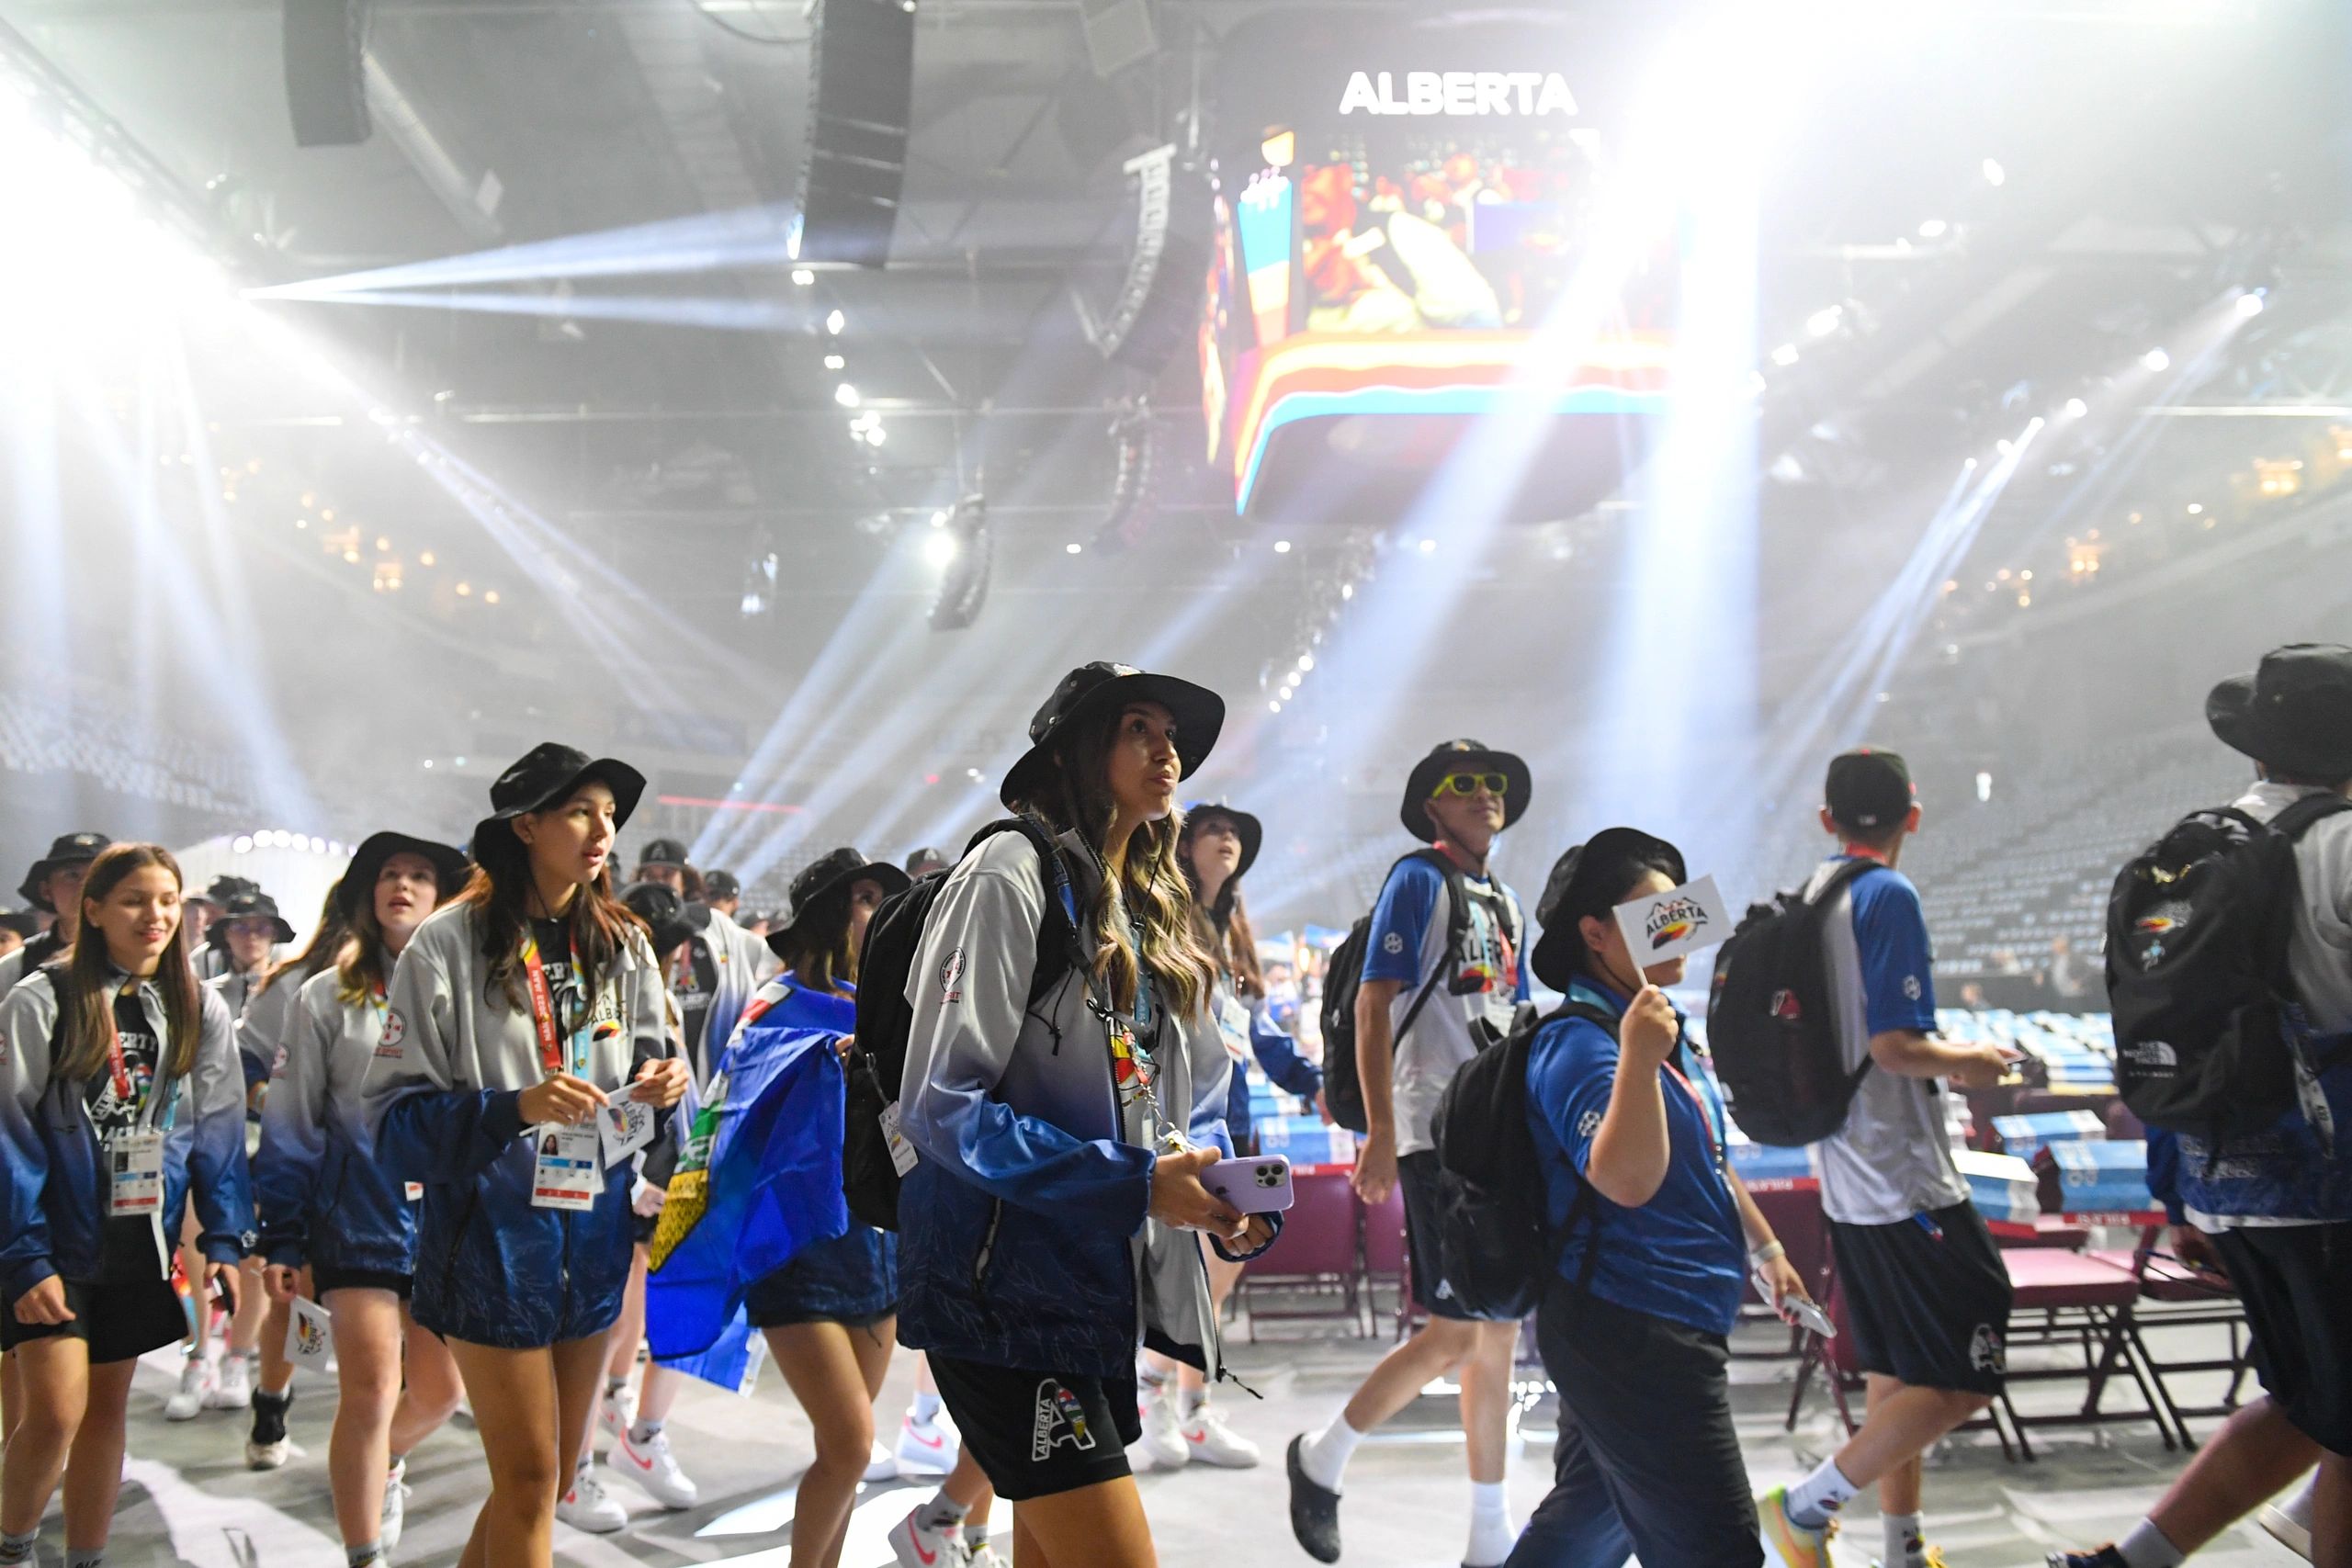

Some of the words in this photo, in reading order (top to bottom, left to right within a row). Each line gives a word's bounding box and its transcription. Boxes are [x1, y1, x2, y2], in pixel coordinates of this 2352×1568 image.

[1339, 71, 1578, 115] ALBERTA
[1646, 907, 1708, 938] ALBERTA
[1036, 1398, 1052, 1455] ALBERTA
